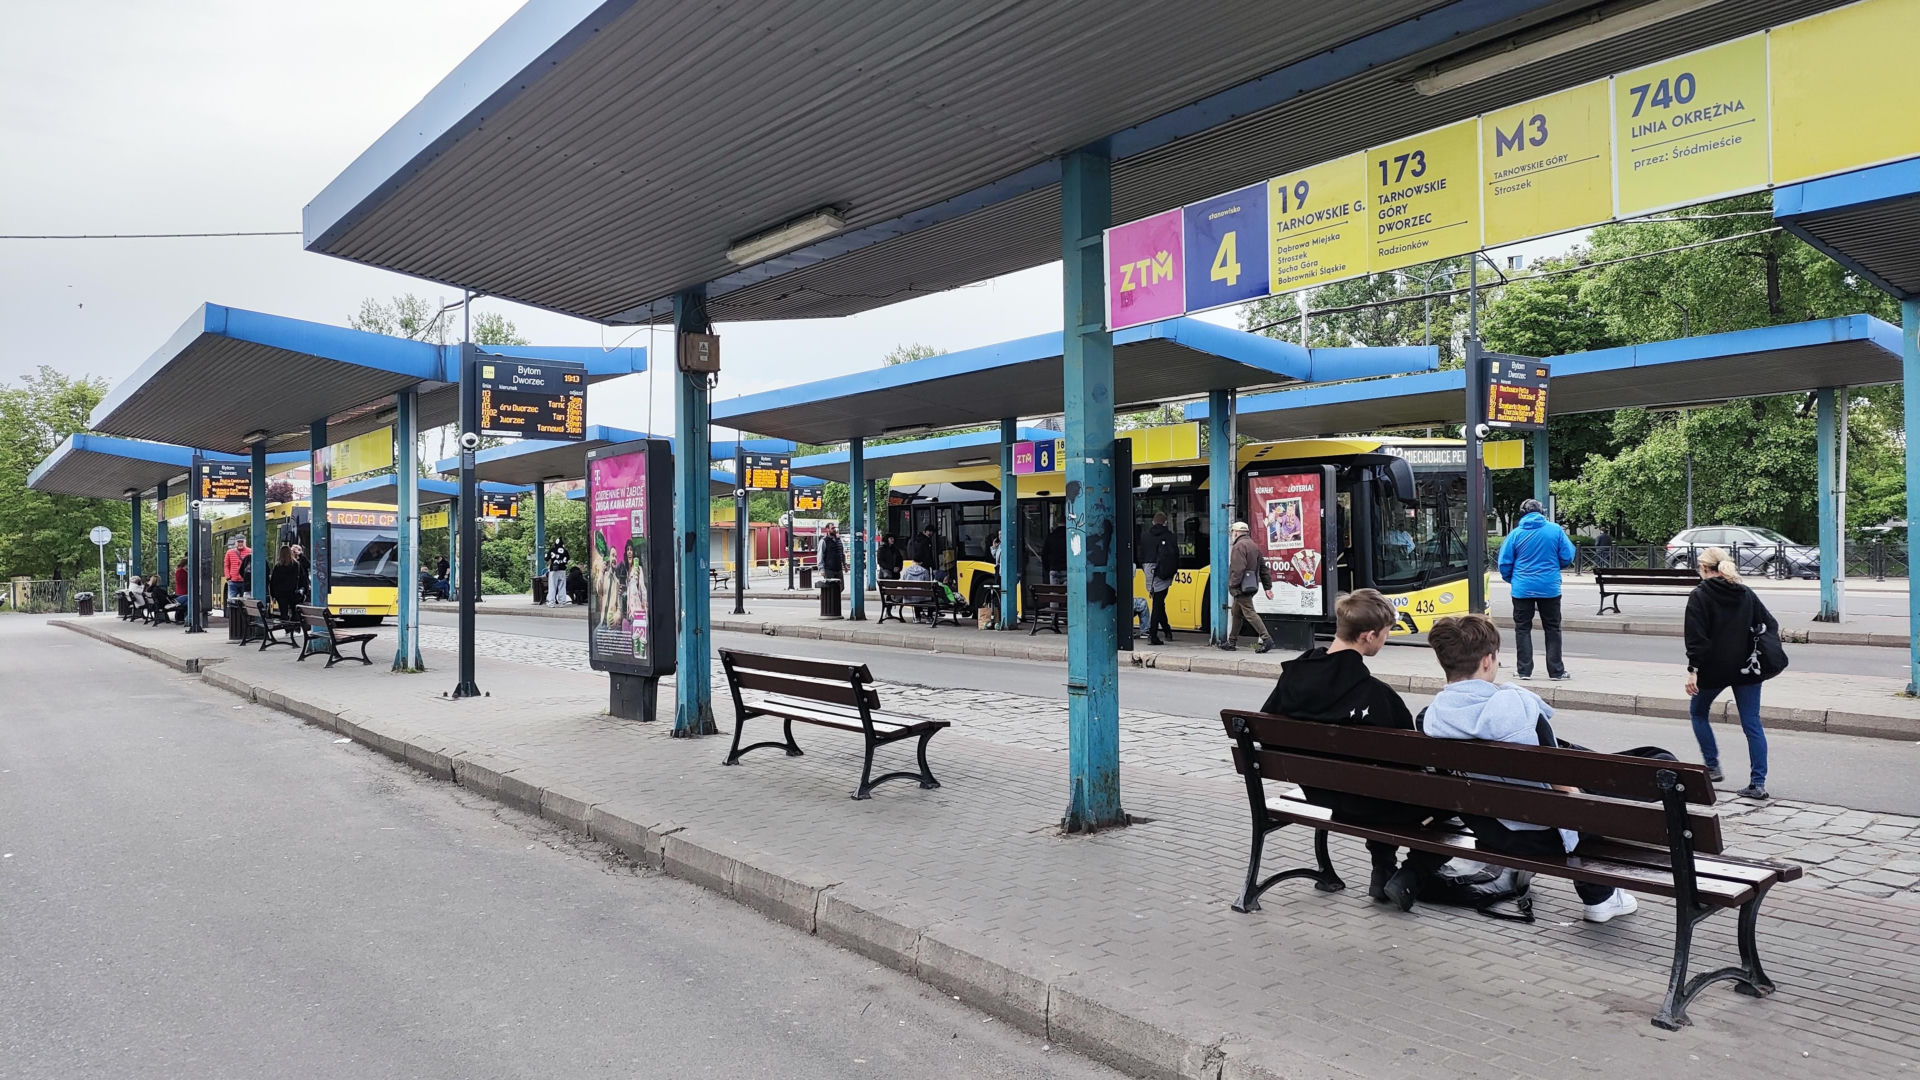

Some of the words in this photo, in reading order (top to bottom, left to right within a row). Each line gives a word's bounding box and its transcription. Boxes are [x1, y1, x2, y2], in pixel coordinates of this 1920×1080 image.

[1630, 72, 1696, 118] 740
[1632, 119, 1667, 139] LINIA
[1671, 98, 1745, 128] OKRĘŻNA
[1496, 114, 1548, 158] M3
[1633, 152, 1669, 172] przez:
[1672, 133, 1743, 160] Śródmieście
[1378, 150, 1426, 186] 173
[1494, 160, 1544, 180] TARNOWSKIE
[1546, 153, 1569, 167] GÓRY
[1378, 178, 1447, 205] TARNOWSKIE
[1494, 178, 1532, 196] Stroszek
[1278, 180, 1310, 214] 19
[1208, 205, 1242, 221] stanowisko
[1277, 202, 1350, 233] TARNOWSKIE
[1354, 200, 1366, 213] G.
[1378, 201, 1408, 220] GÓRY
[1378, 212, 1432, 235] DWORZEC
[1277, 240, 1311, 256] Dąbrowa
[1312, 232, 1341, 247] Miejska
[1378, 239, 1430, 257] Radzionków
[1210, 231, 1241, 286] 4
[1277, 252, 1308, 264] Stroszek
[1278, 262, 1300, 276] Sucha
[1301, 259, 1319, 271] Góra
[1120, 251, 1174, 293] ZTM
[1278, 269, 1318, 286] Bobrowniki
[1320, 262, 1346, 278] Śląskie
[518, 366, 541, 376] Bytom
[512, 376, 544, 386] Dworzec
[1017, 453, 1032, 464] ZTM
[1041, 451, 1048, 467] 8
[1404, 450, 1452, 464] MIECHOWICE
[625, 497, 643, 508] GRATIS
[337, 514, 375, 525] ROJCA
[1175, 572, 1192, 584] 436
[1416, 600, 1435, 614] 436
